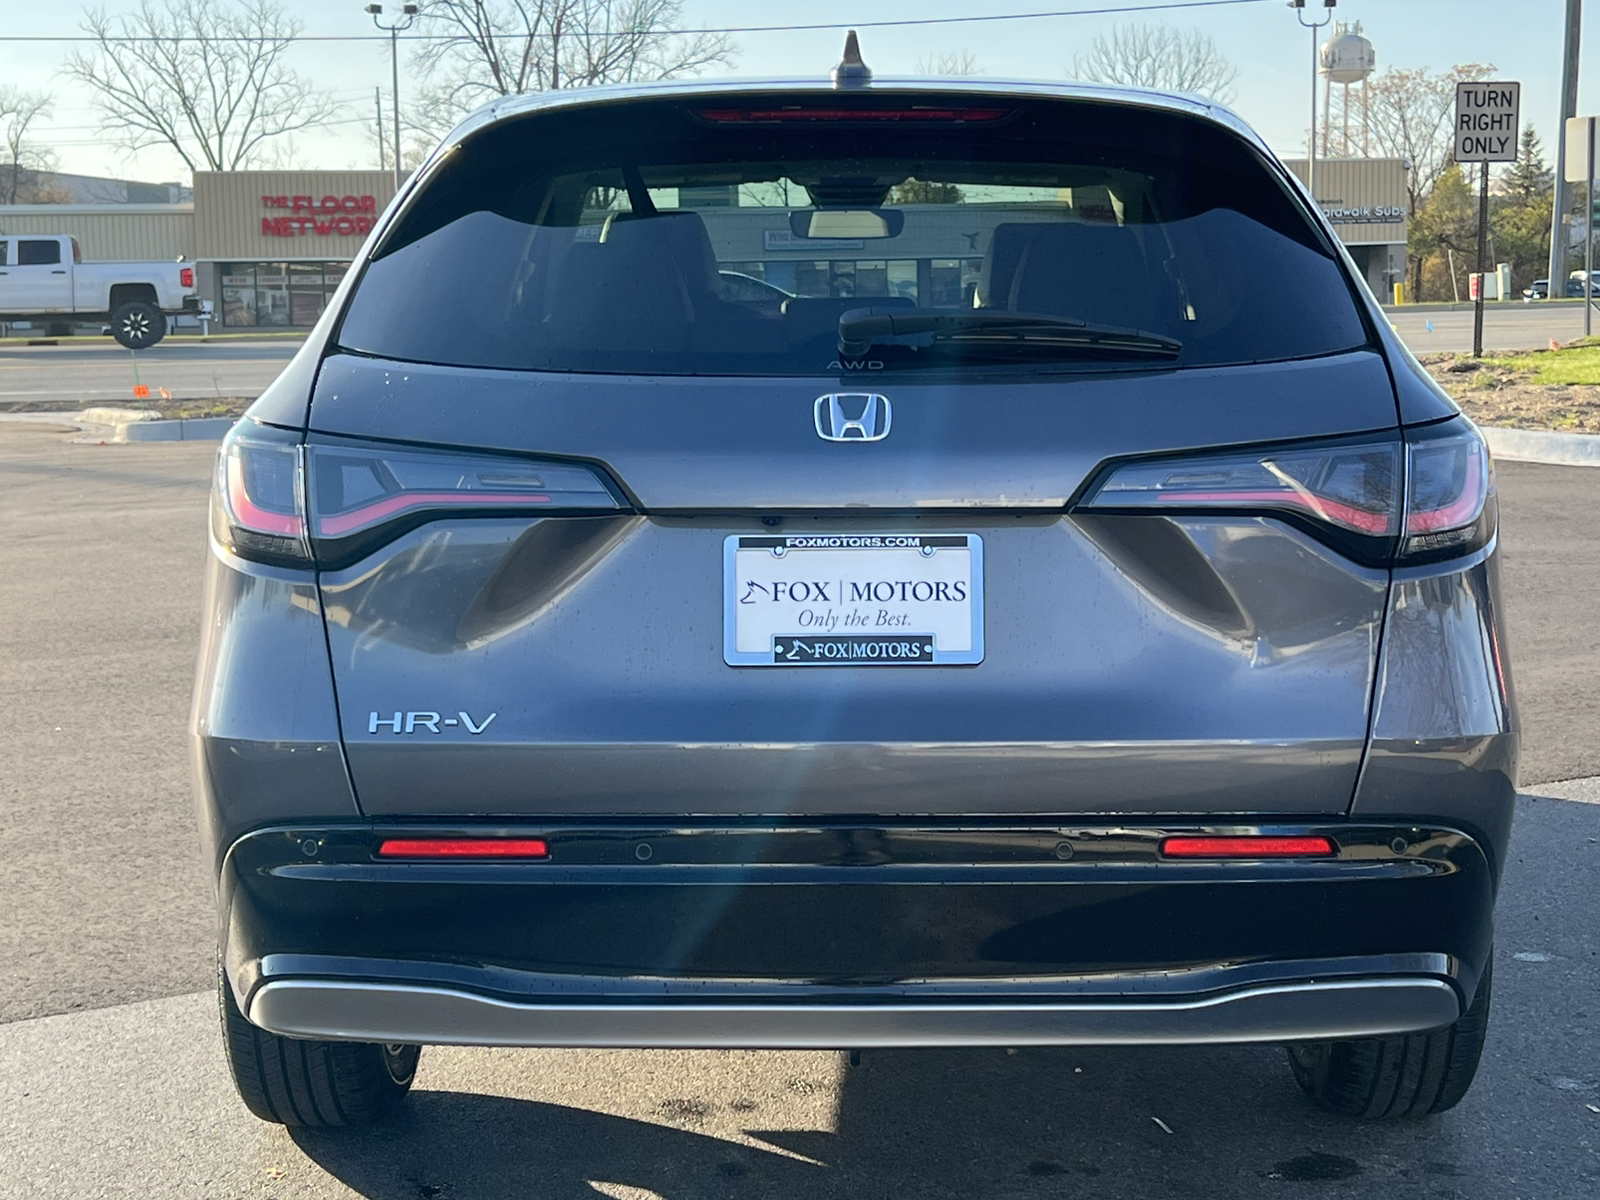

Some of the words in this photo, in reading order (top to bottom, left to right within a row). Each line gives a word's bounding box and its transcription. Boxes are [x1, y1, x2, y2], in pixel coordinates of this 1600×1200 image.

[1463, 90, 1512, 108] TURN
[1460, 113, 1514, 131] RIGHT
[1461, 136, 1510, 154] ONLY
[261, 195, 289, 208] THE
[291, 195, 376, 215] FLOOR
[1323, 206, 1370, 217] ardwalk
[1375, 206, 1407, 216] Subs
[826, 361, 884, 370] AWD
[786, 537, 921, 548] FOXMOTORS.COM
[772, 581, 830, 602] FOX
[849, 580, 967, 602] MOTORS
[798, 609, 839, 632] Only
[844, 608, 868, 627] the
[874, 609, 912, 627] Best.
[368, 711, 498, 735] HR-V
